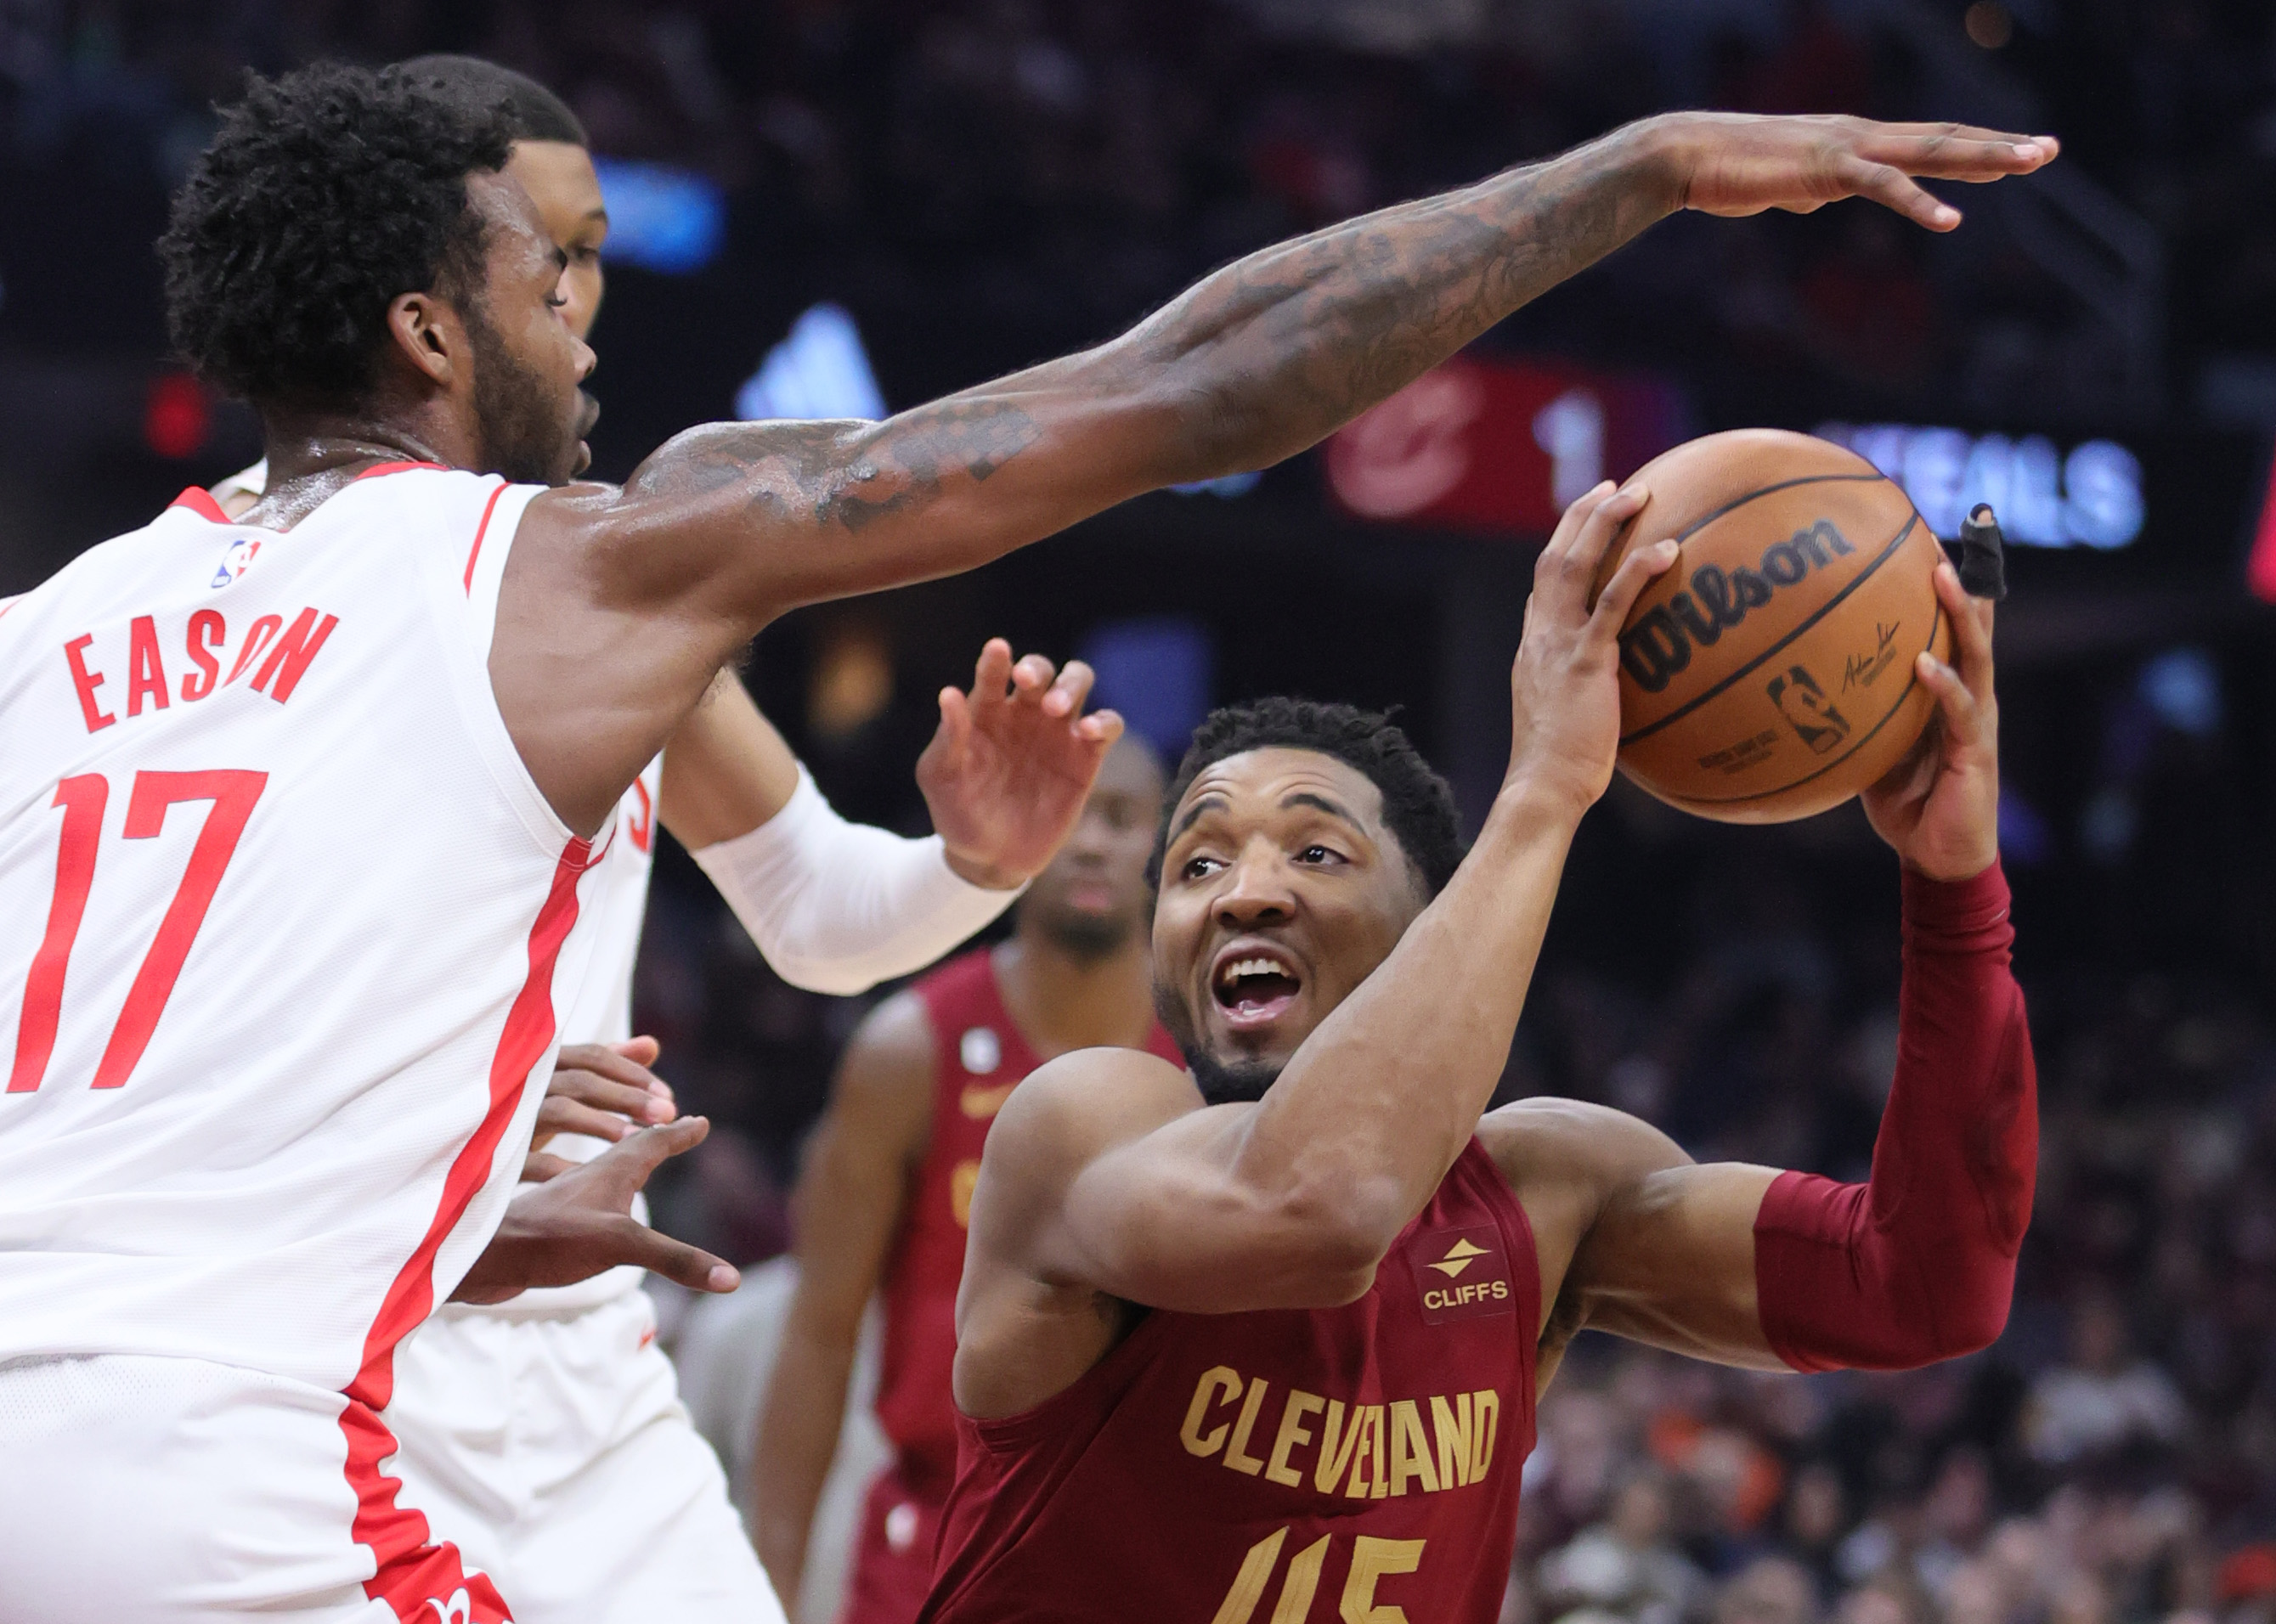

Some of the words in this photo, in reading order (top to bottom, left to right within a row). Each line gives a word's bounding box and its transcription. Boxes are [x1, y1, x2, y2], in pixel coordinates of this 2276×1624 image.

[64, 607, 339, 733] EASON
[1617, 518, 1855, 693] Wilson
[6, 769, 269, 1093] 17
[1423, 1280, 1508, 1309] CLIFFS
[1180, 1365, 1499, 1498] CLEVELAND
